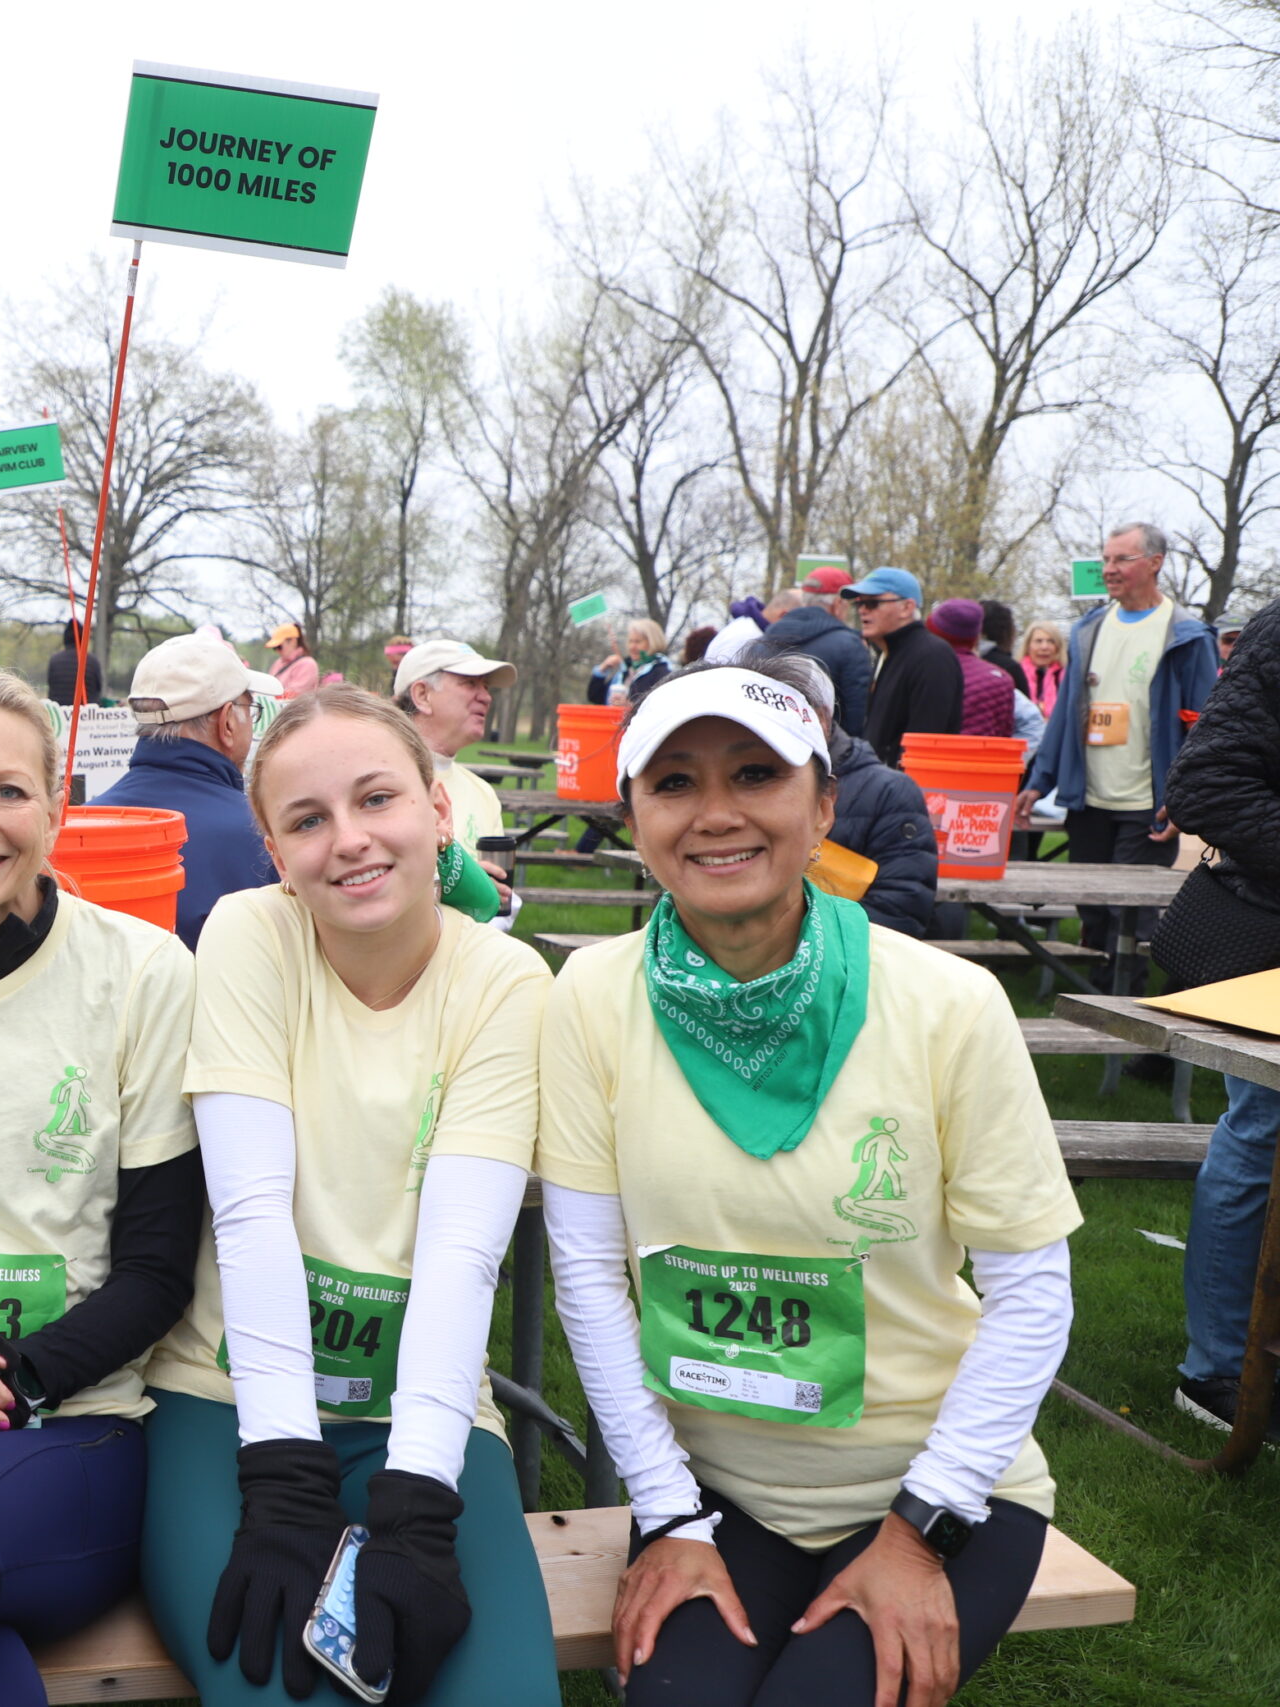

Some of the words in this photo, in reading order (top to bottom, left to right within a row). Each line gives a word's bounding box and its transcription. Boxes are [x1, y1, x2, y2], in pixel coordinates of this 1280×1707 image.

[159, 127, 293, 165] JOURNEY
[298, 146, 337, 171] OF
[167, 161, 232, 191] 1000
[237, 173, 318, 204] MILES
[18, 457, 46, 470] CLUB
[77, 761, 108, 770] August
[93, 746, 134, 756] Wainwr
[664, 1254, 717, 1277] STEPPING
[721, 1266, 738, 1279] UP
[743, 1266, 759, 1280] TO
[762, 1268, 829, 1287] WELLNESS
[318, 1274, 333, 1289] UP
[336, 1280, 350, 1295] TO
[352, 1285, 408, 1304] WELLNESS
[320, 1291, 345, 1306] 2026
[729, 1281, 757, 1292] 2026
[309, 1299, 383, 1358] 204
[685, 1288, 812, 1348] 1248
